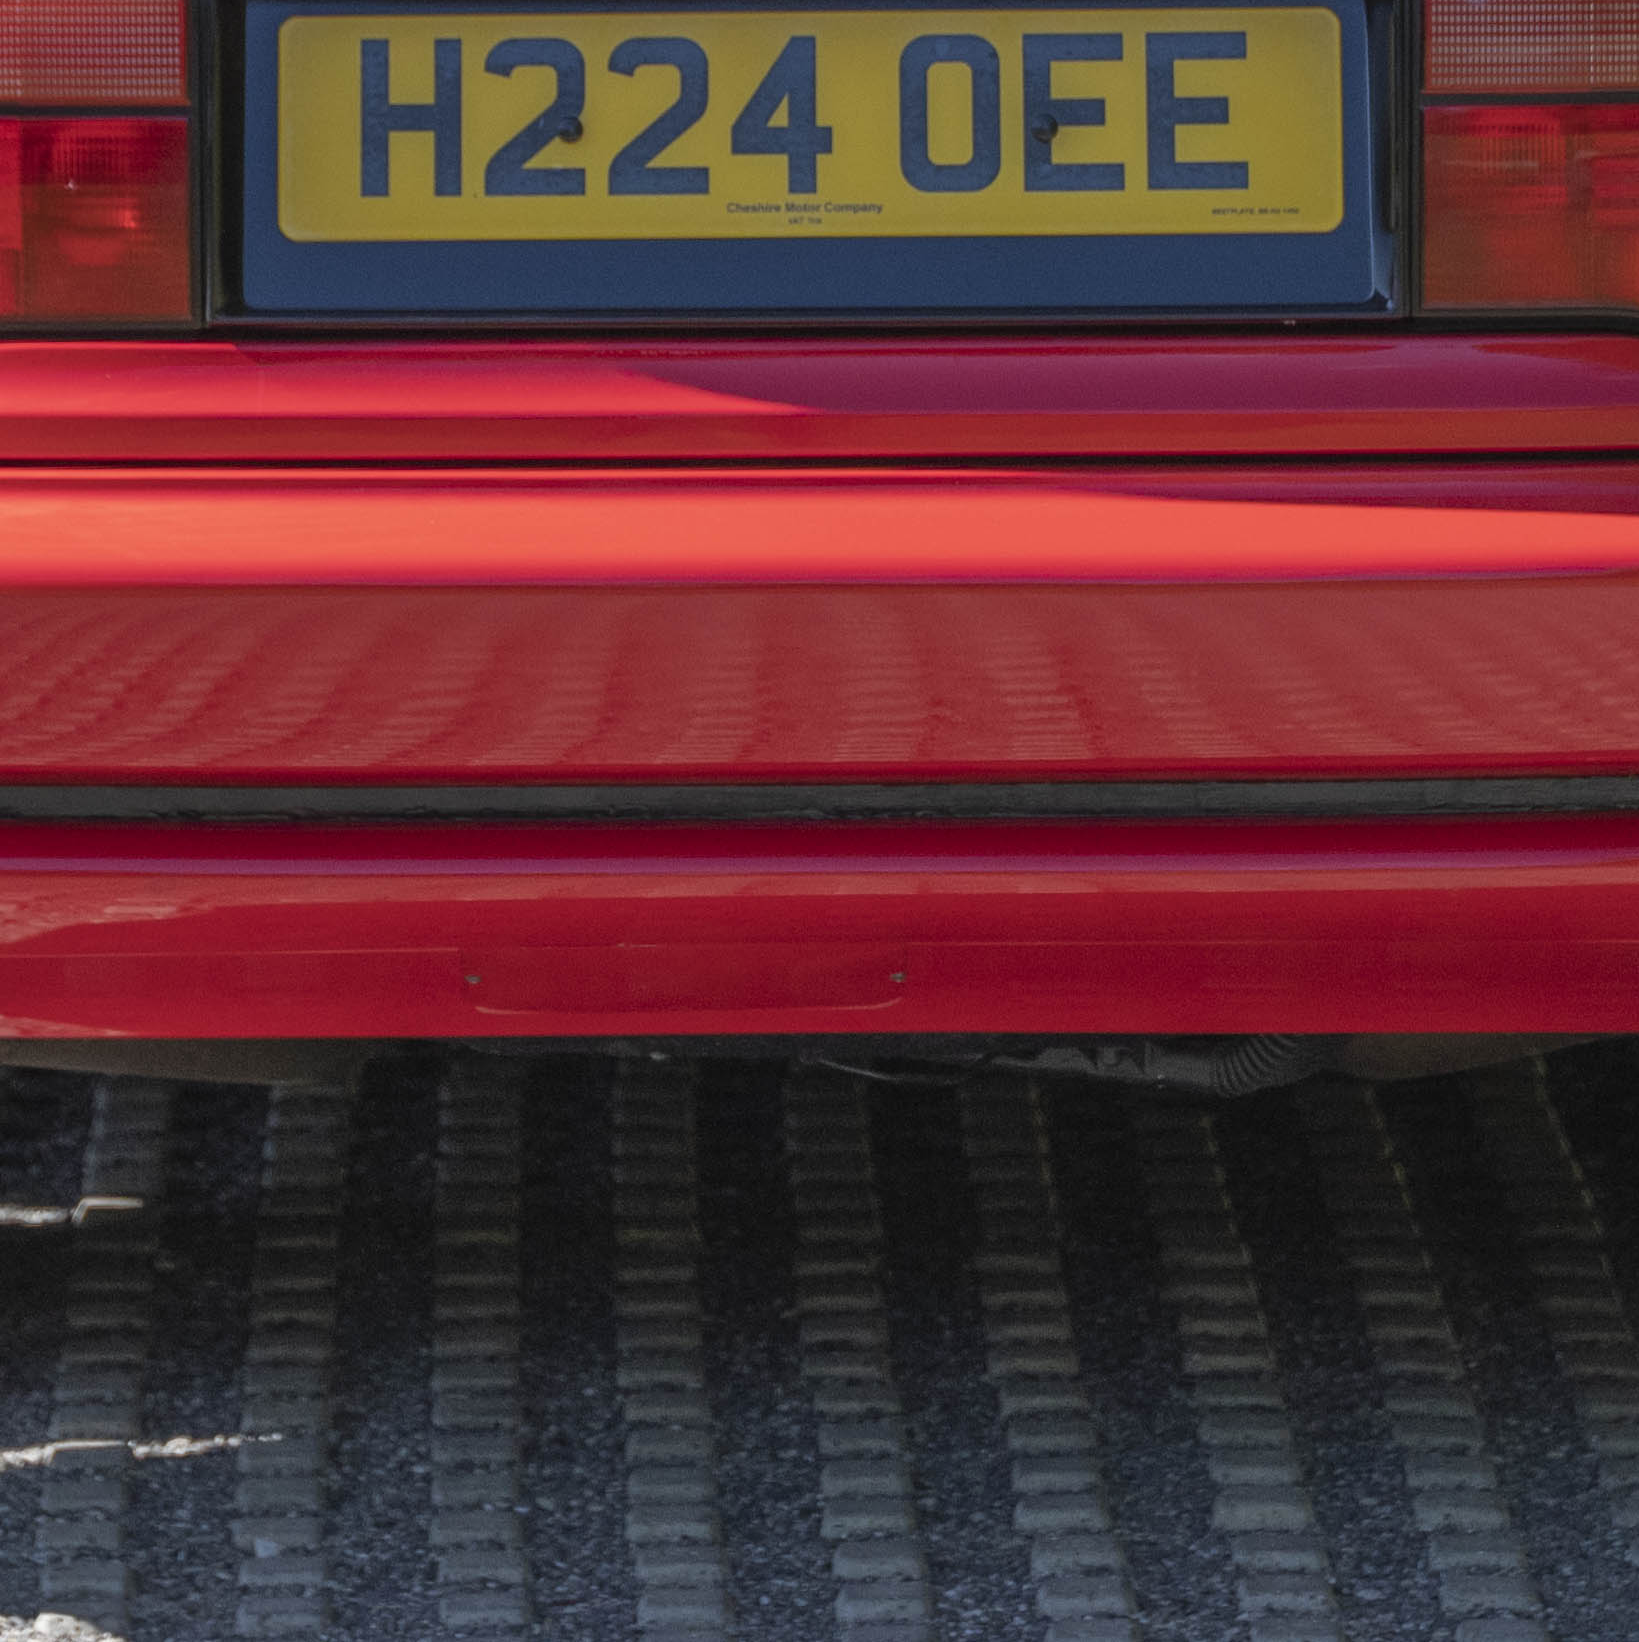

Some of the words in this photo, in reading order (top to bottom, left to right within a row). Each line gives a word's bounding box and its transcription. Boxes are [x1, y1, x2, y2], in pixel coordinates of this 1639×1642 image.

[360, 35, 832, 196] H224
[900, 32, 1248, 192] OEE
[726, 202, 781, 213] Cheshire
[785, 202, 820, 212] Motor
[824, 202, 883, 214] Company
